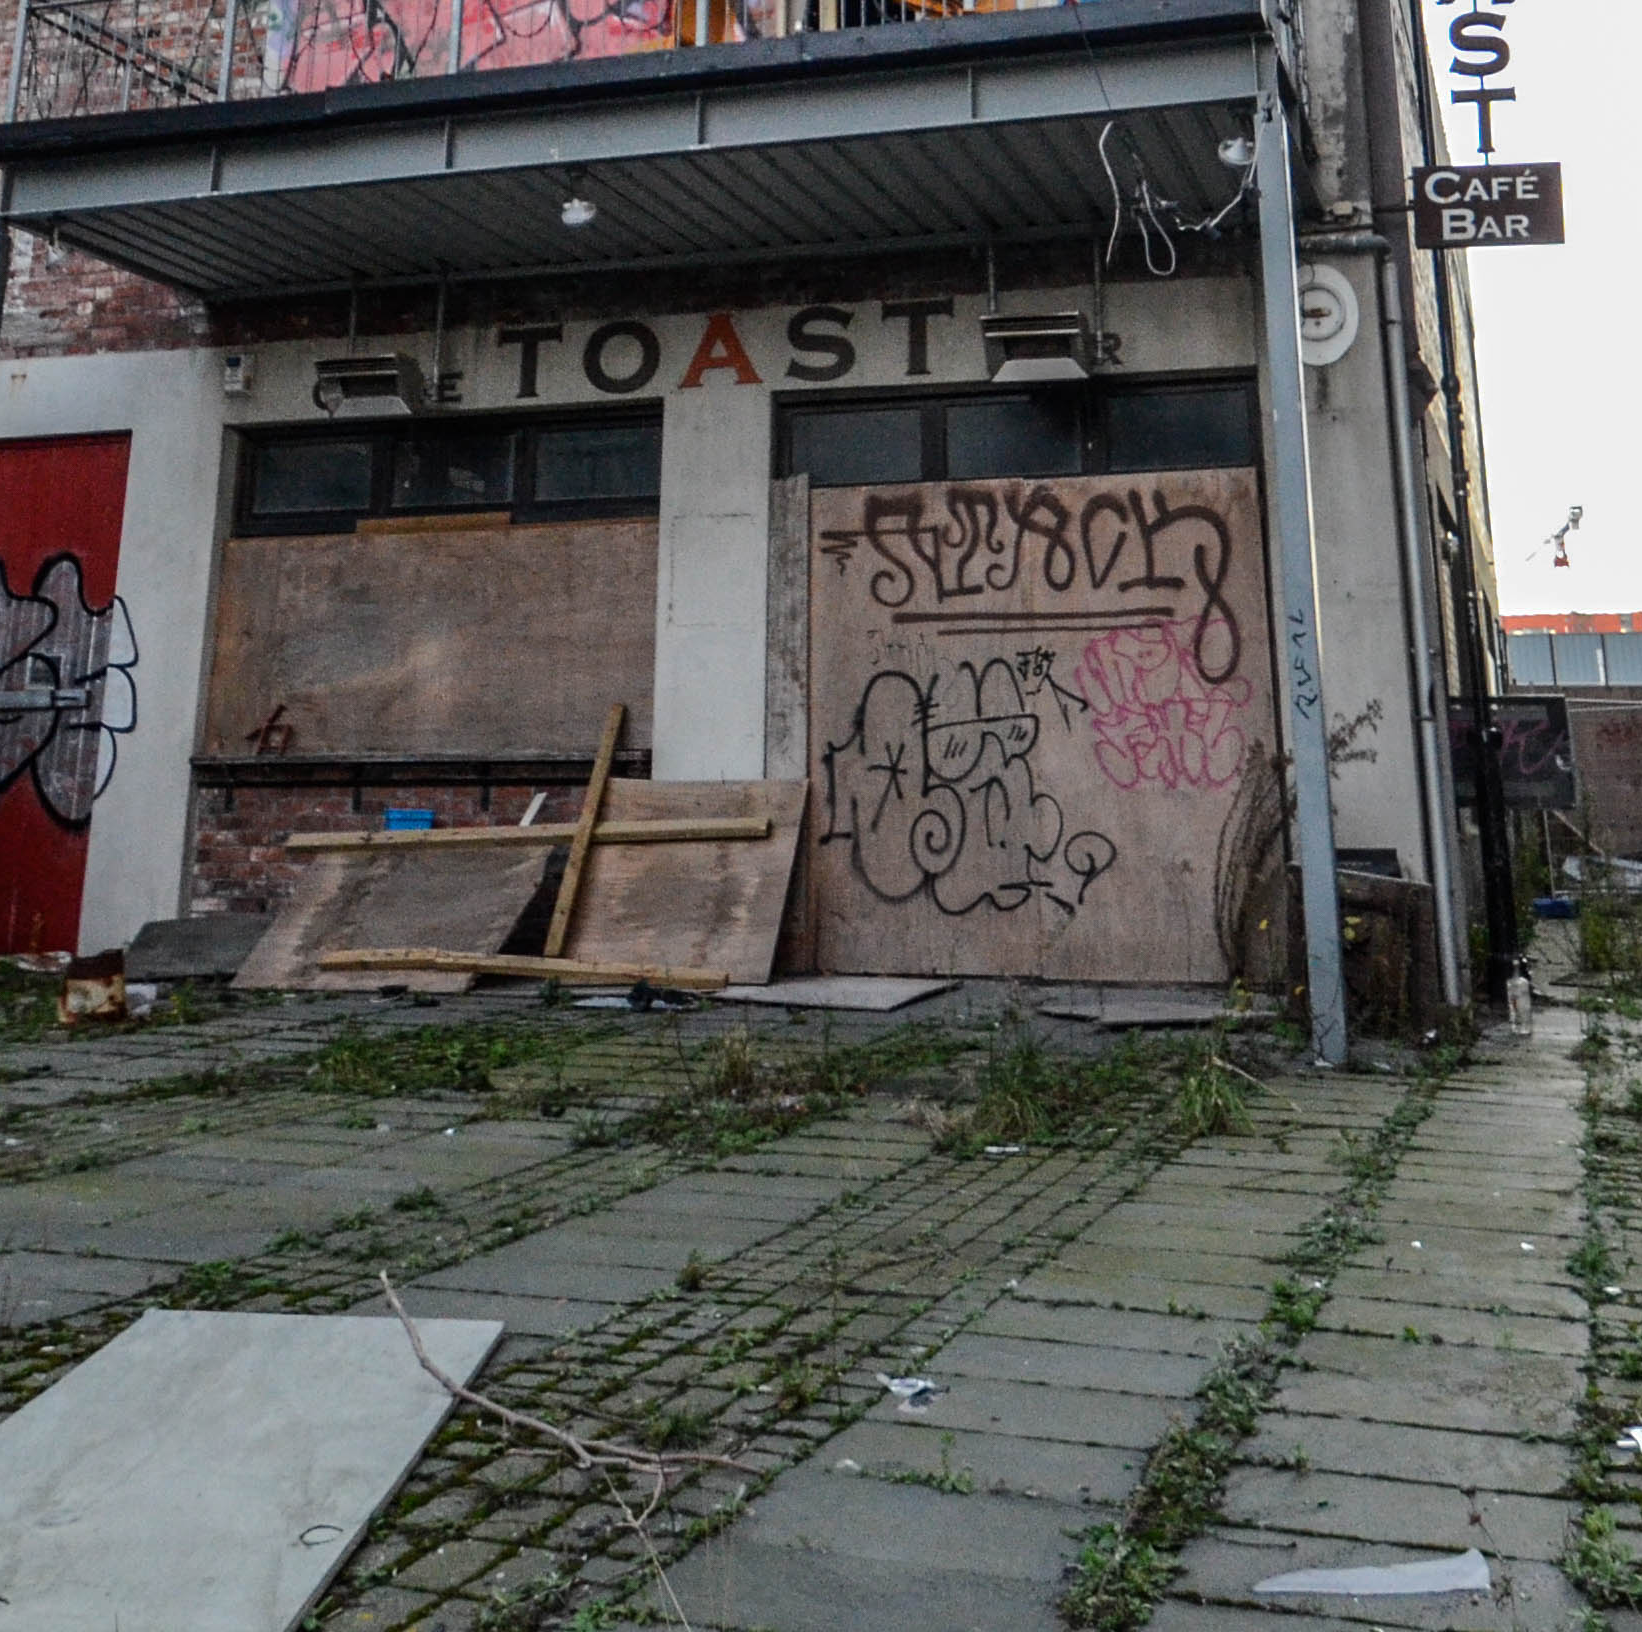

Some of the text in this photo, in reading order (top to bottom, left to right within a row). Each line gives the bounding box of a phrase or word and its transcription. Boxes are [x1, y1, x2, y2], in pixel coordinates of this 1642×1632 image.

[1423, 169, 1541, 205] CAFÉ
[1441, 207, 1531, 242] BAR
[497, 297, 955, 399] TOAST
